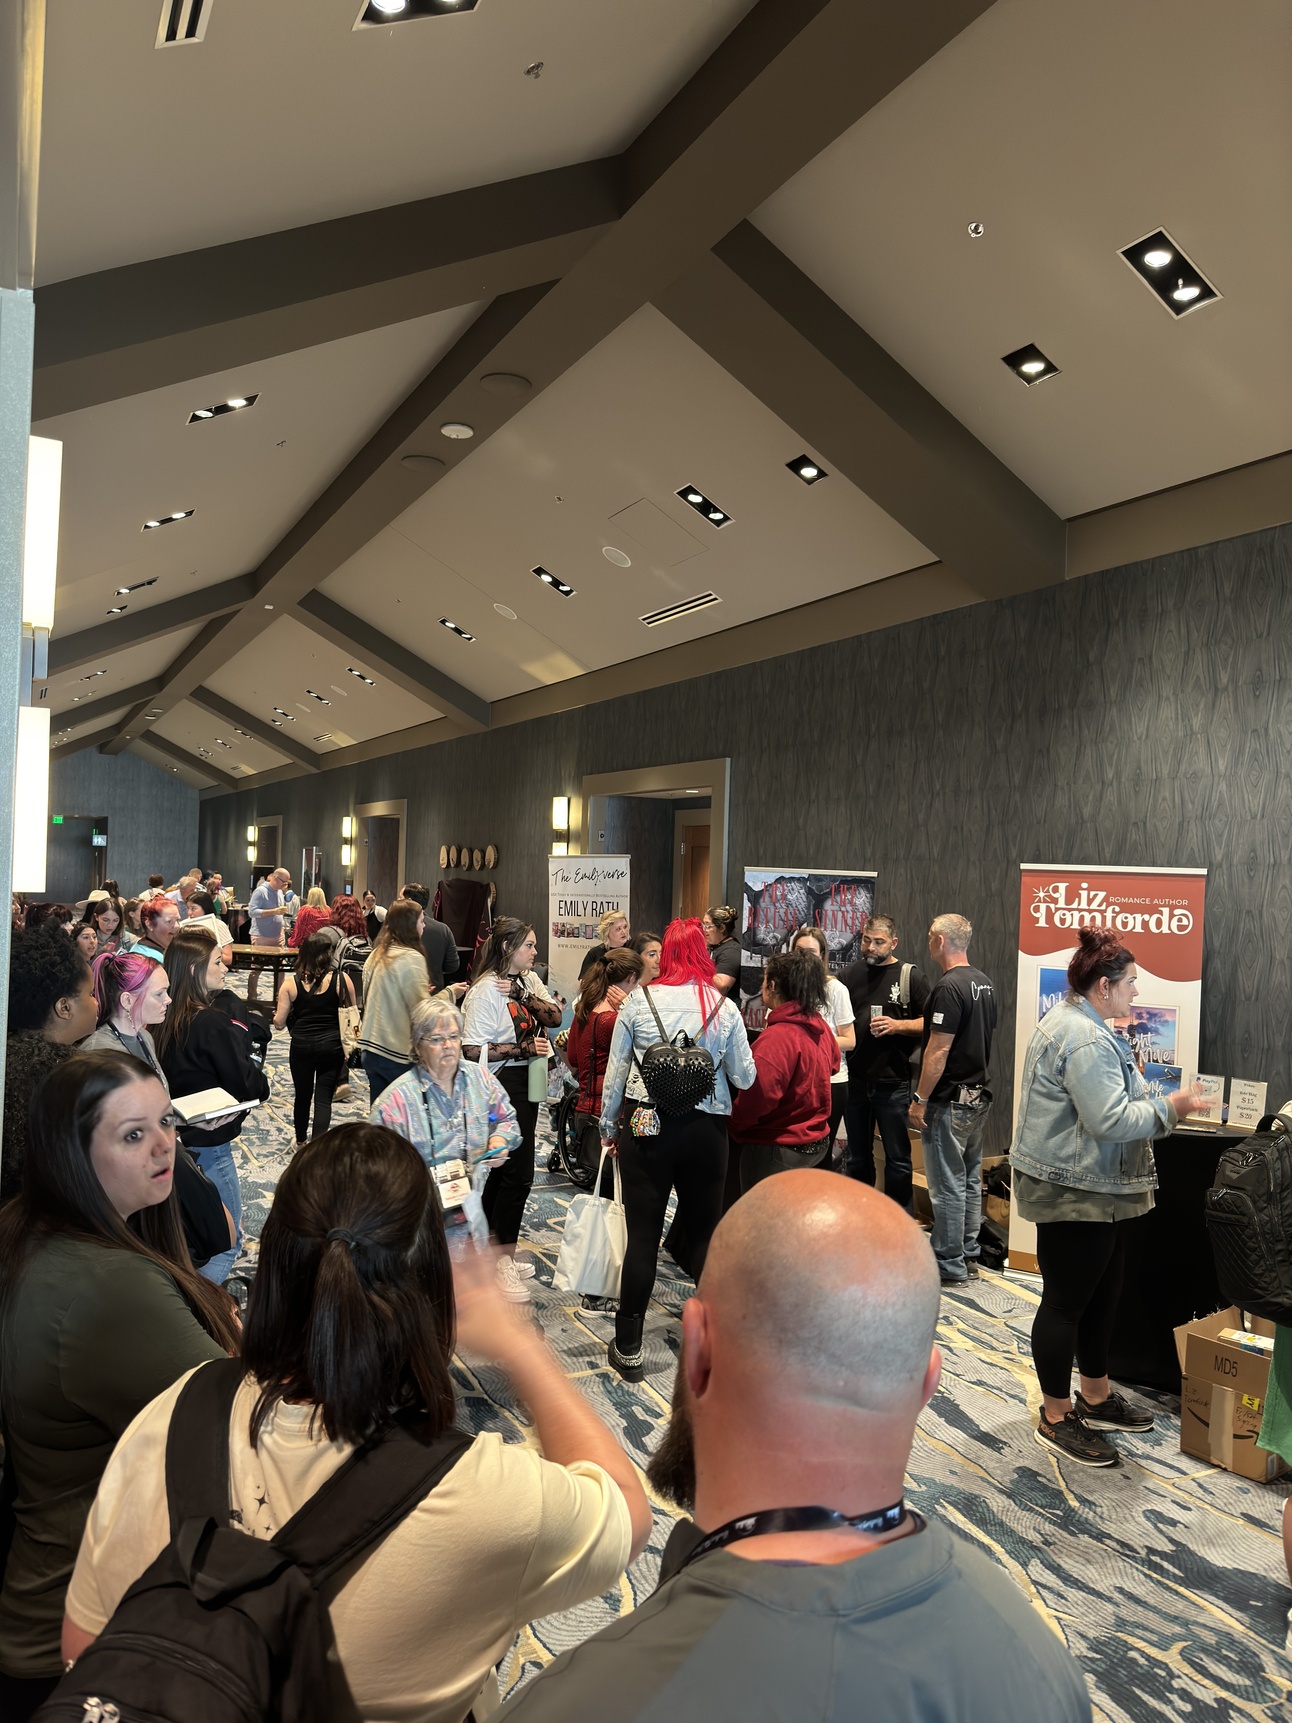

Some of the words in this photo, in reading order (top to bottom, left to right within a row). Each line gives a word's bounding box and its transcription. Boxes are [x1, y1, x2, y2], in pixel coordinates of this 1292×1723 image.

[552, 868, 571, 886] The
[762, 882, 786, 904] THE
[830, 884, 857, 906] THE
[1049, 882, 1107, 910] Liz
[1109, 896, 1151, 905] ROMANCE
[1153, 898, 1189, 906] AUTHOR
[558, 900, 588, 916] EMILY
[592, 902, 618, 917] RATH
[748, 906, 798, 930] RITUAL
[1030, 902, 1193, 935] Tomforde
[1213, 1355, 1238, 1377] MD5
[1040, 1421, 1056, 1440] HOKA
